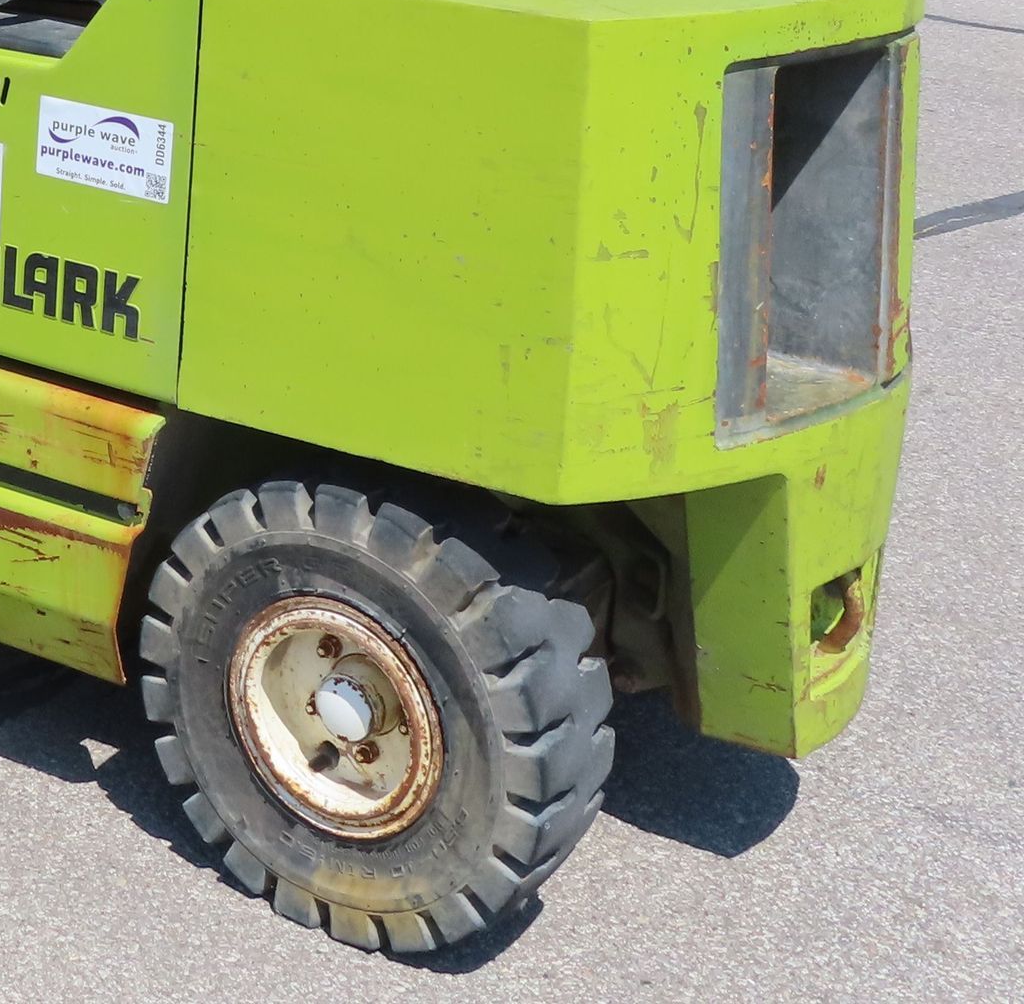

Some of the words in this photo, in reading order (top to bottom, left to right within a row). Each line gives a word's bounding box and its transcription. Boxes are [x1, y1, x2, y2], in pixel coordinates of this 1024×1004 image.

[52, 120, 95, 138] purple
[100, 130, 136, 147] wave
[155, 123, 167, 166] DD6344
[40, 144, 145, 177] purplewave.com
[56, 167, 82, 180] Straight.
[84, 173, 108, 186] Simple.
[109, 180, 126, 191] Sold.
